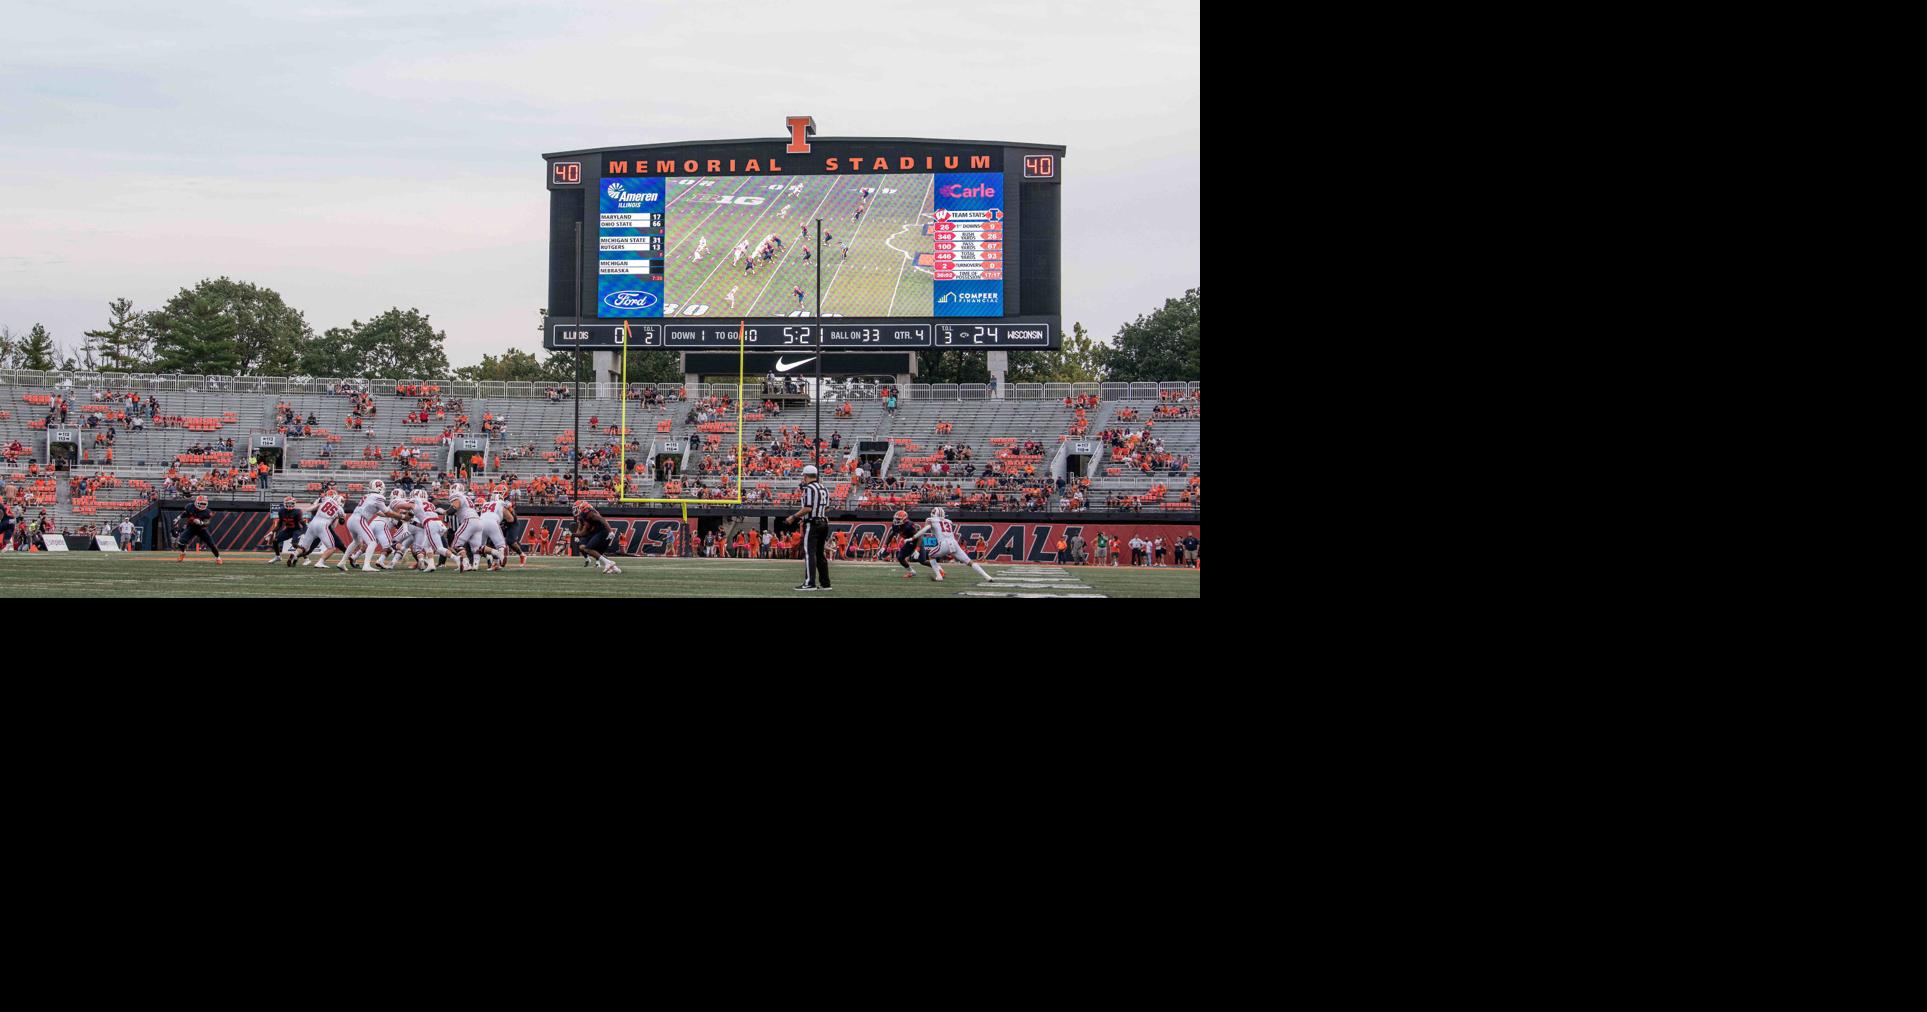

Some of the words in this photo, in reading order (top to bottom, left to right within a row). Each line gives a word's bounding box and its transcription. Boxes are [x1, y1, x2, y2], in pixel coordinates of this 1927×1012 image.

[609, 160, 782, 175] MEMORIAL
[825, 155, 990, 171] STADIUM
[1027, 158, 1050, 174] 40
[556, 165, 578, 181] 40
[618, 191, 658, 202] Ameren
[949, 184, 995, 198] Carle
[614, 293, 647, 306] Ford
[563, 331, 589, 340] ILLIOIS
[645, 332, 653, 344] 2
[671, 331, 695, 340] DOWN
[715, 331, 726, 340] TO
[727, 331, 739, 340] GO
[744, 329, 757, 342] 10
[831, 331, 849, 340] BALL
[850, 331, 861, 340] ON
[862, 329, 880, 342] 33
[895, 331, 912, 340] QTR.
[916, 329, 924, 341] 4
[945, 331, 952, 344] 3
[973, 326, 998, 344] 24
[1007, 330, 1043, 339] WISCONSIN
[320, 501, 338, 517] 85
[482, 502, 497, 513] 54
[939, 520, 952, 533] 13
